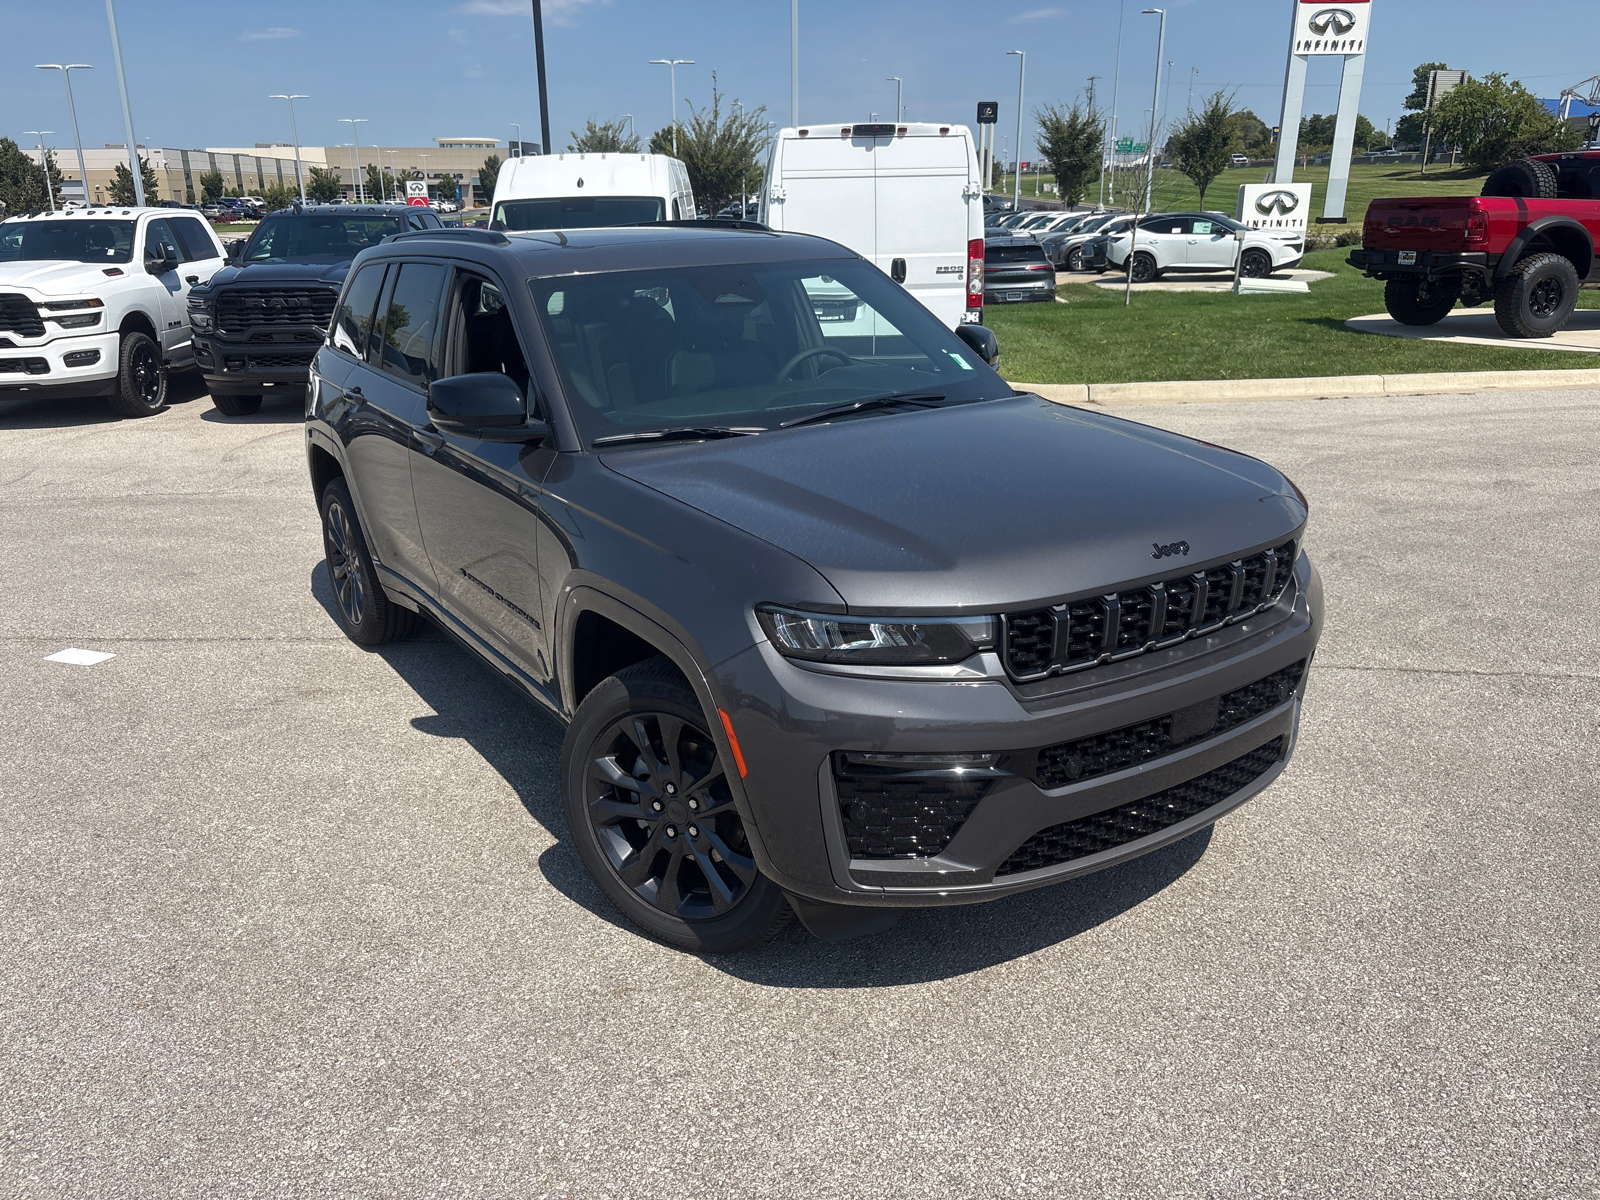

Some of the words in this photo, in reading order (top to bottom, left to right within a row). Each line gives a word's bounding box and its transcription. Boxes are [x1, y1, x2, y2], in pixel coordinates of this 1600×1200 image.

[1296, 39, 1363, 51] INFINITI
[1247, 219, 1303, 228] INFINITI
[1387, 216, 1441, 226] RAM
[245, 297, 311, 308] RAM
[1150, 540, 1190, 560] Jeep
